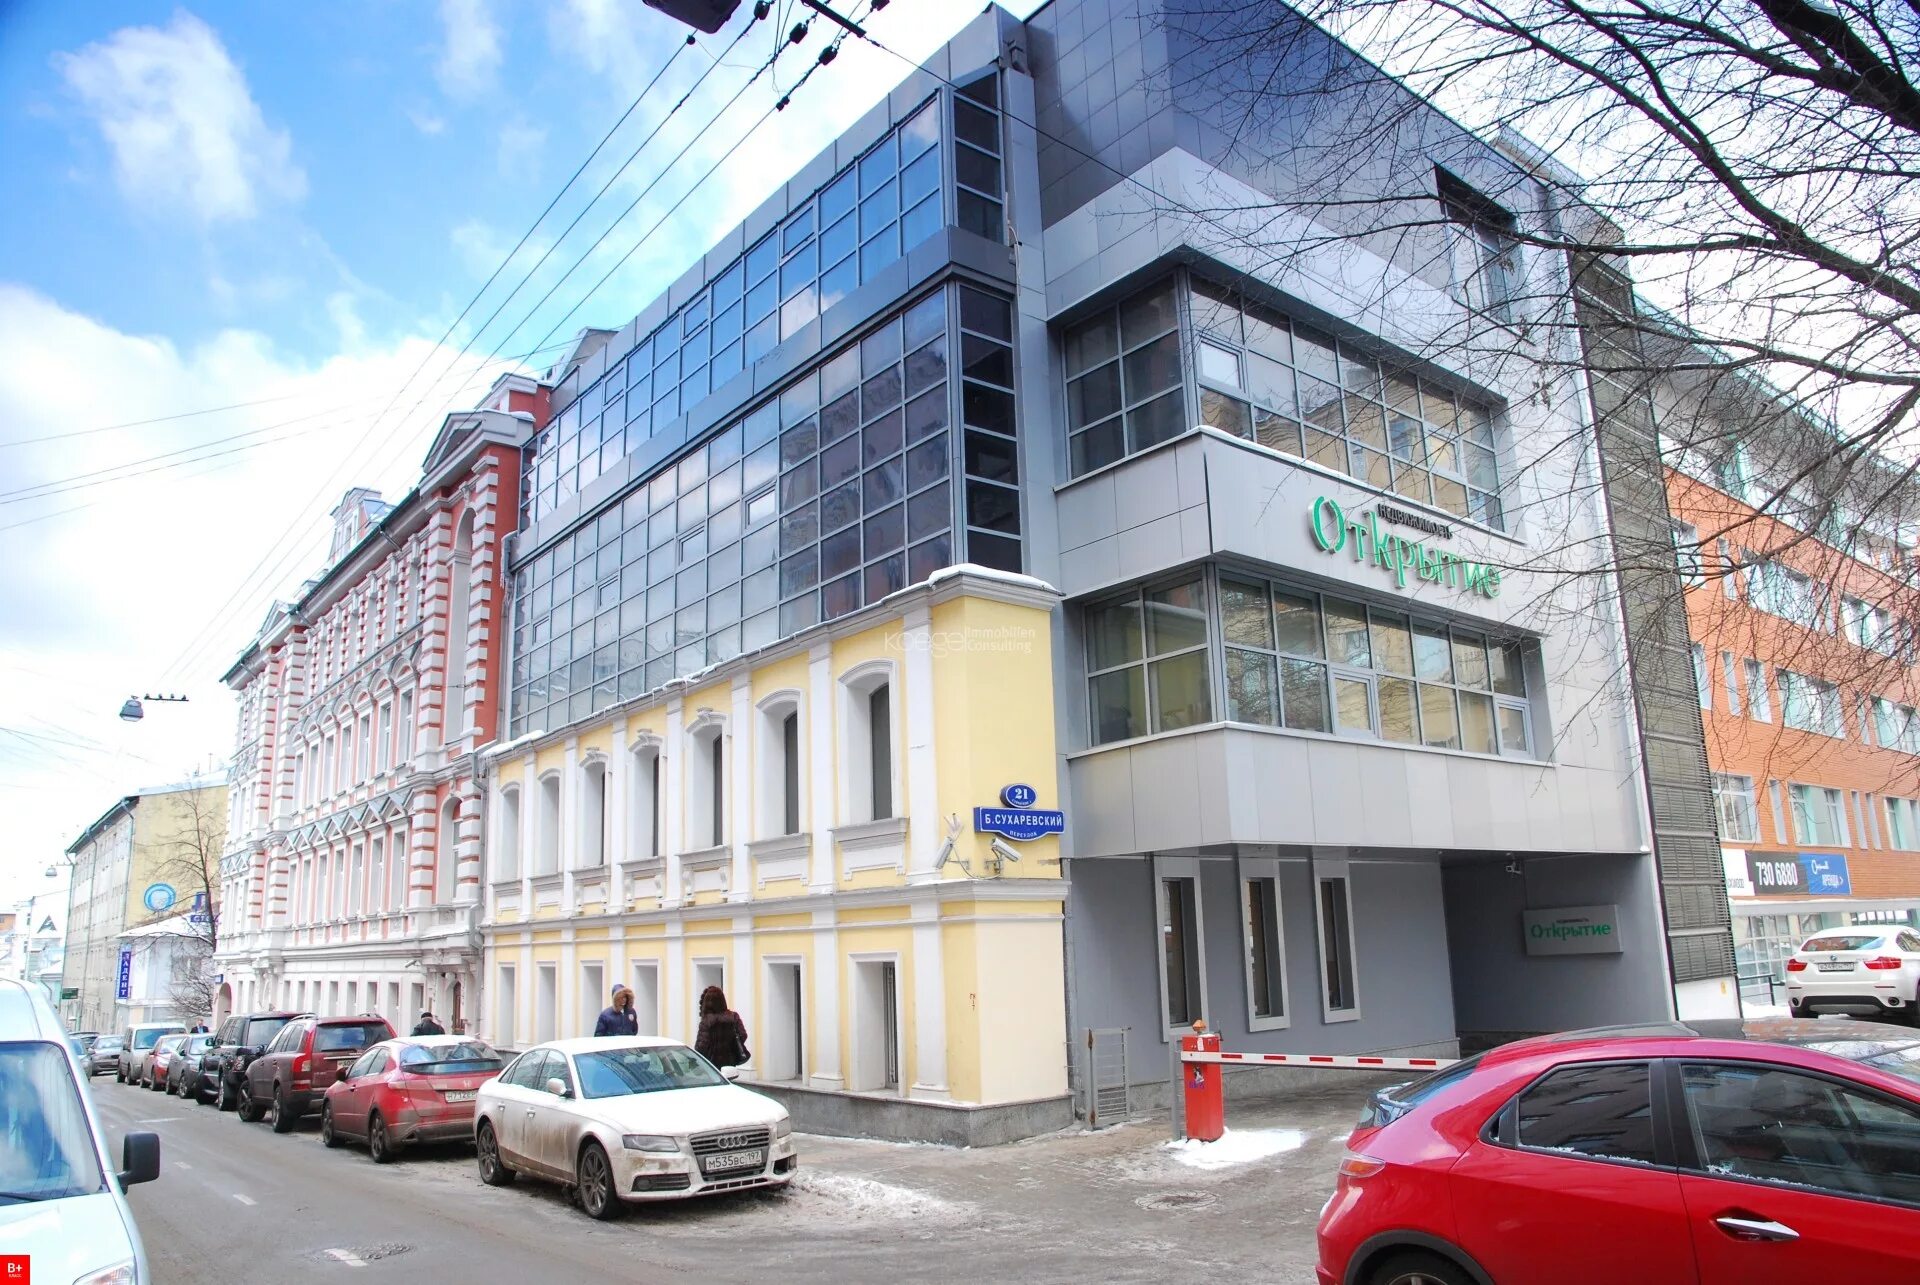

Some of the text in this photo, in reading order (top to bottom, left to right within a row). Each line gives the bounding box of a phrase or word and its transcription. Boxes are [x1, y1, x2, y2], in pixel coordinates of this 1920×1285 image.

[1307, 495, 1501, 599] Открытие
[1014, 787, 1028, 800] 21
[1009, 830, 1038, 838] ПЕРЕУЛОК
[1755, 861, 1774, 886] 730
[1775, 862, 1798, 886] 6880
[1530, 922, 1611, 941] Открытие
[747, 1151, 760, 1161] 197
